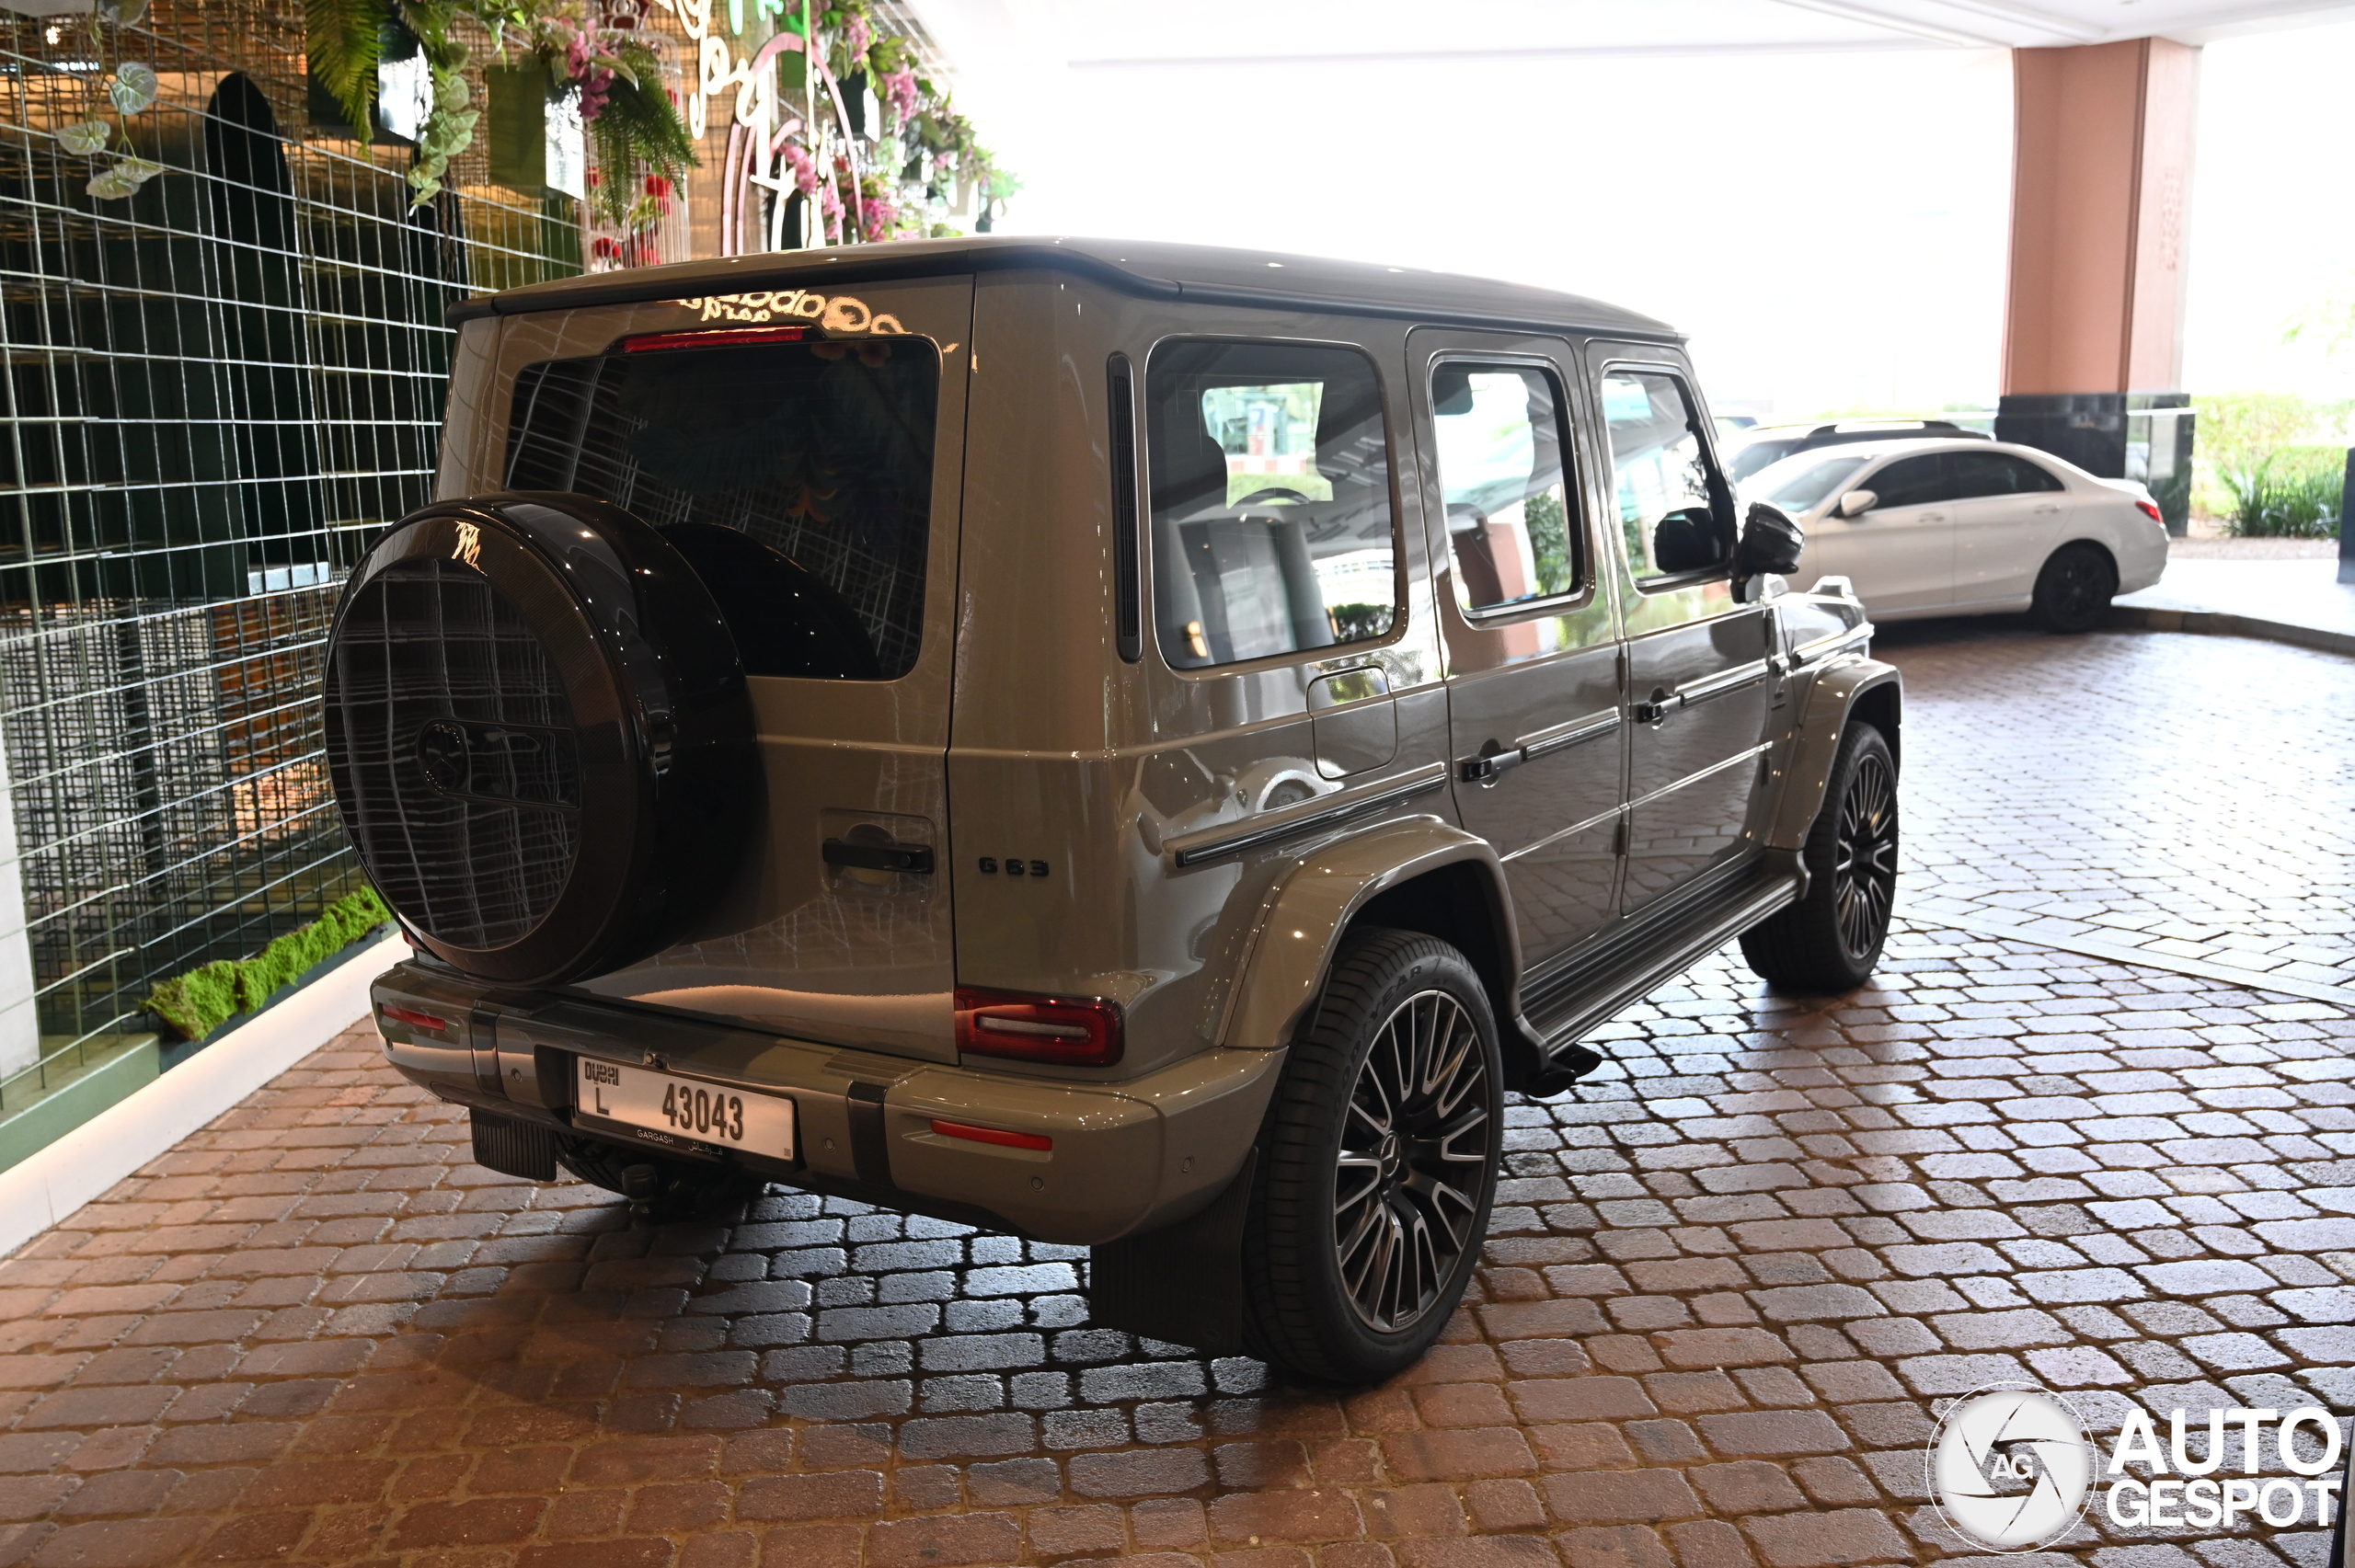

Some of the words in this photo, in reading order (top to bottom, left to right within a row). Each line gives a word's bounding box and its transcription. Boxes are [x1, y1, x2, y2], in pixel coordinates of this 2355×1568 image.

[595, 1087, 610, 1116] L
[661, 1082, 744, 1140] 43043
[637, 1128, 674, 1145] GARGASH
